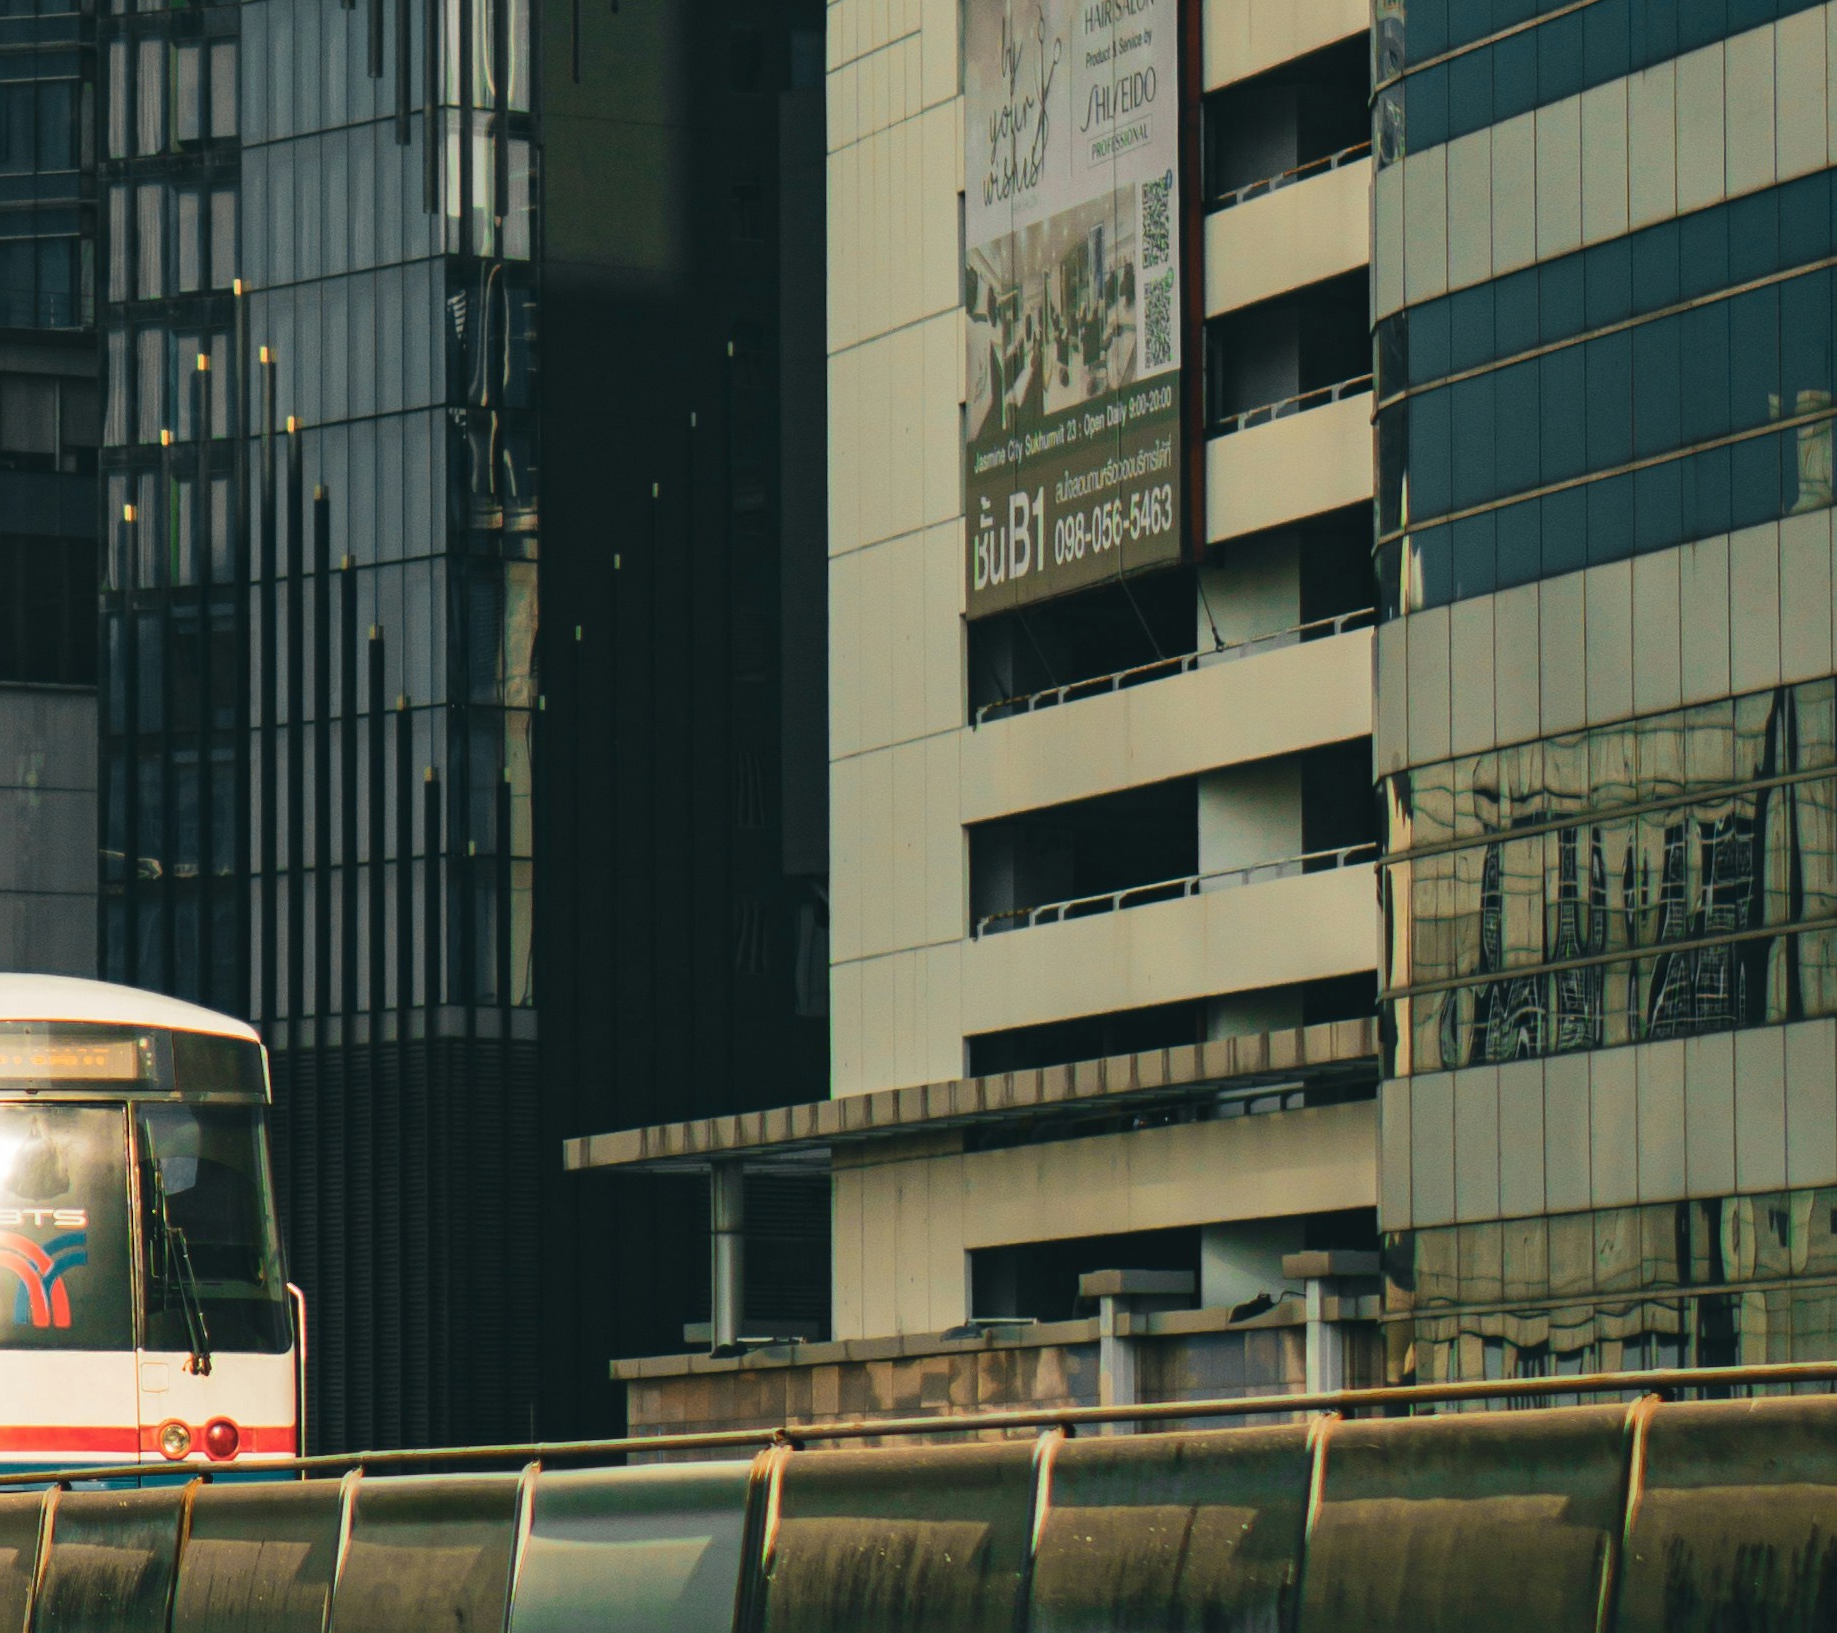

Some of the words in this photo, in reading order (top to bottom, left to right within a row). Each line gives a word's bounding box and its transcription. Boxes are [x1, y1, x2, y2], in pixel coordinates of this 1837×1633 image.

[1086, 47, 1111, 68] Product
[1118, 34, 1142, 56] Service
[1144, 28, 1152, 46] by
[1079, 66, 1156, 133] SHISEIDO
[1091, 123, 1149, 161] PROFESSIONAL
[974, 447, 1005, 474] Jasmine
[1008, 440, 1023, 464] City
[1025, 424, 1064, 455] Sukhumvit
[1067, 419, 1077, 441] 23
[1084, 413, 1105, 439] Open
[1107, 401, 1127, 427] Daily
[1129, 385, 1172, 419] 9:00-20:00
[974, 496, 1005, 591] ชั้น
[1009, 486, 1044, 580] B1
[1055, 483, 1172, 565] 098-056-5463
